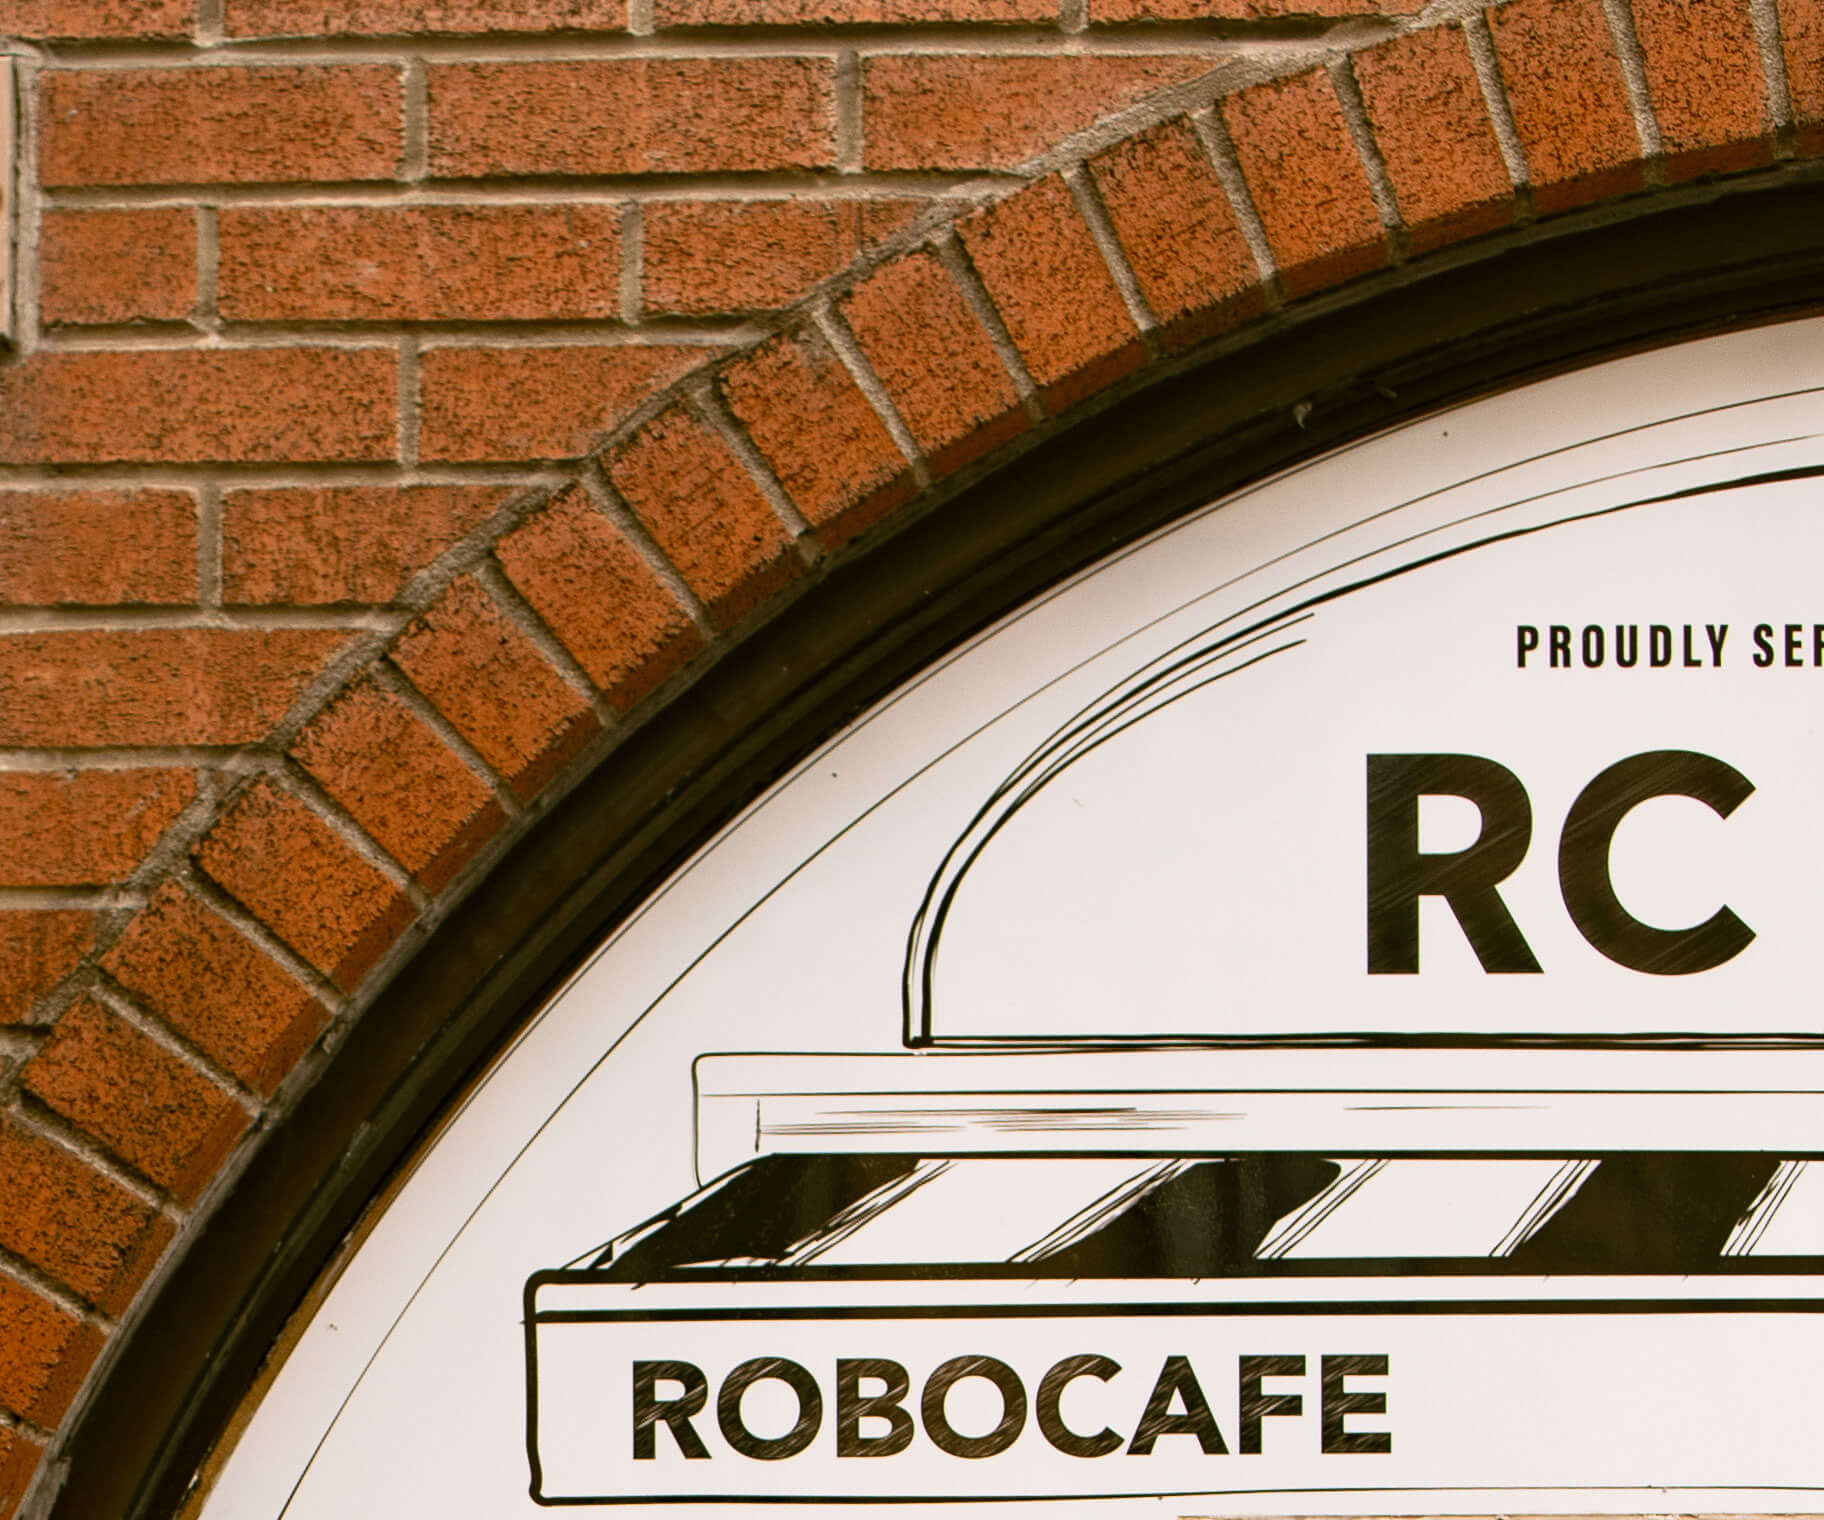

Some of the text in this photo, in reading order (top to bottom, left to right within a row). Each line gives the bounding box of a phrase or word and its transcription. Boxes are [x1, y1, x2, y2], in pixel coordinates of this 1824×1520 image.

[1517, 624, 1729, 669] PROUDLY
[1366, 749, 1757, 976] RC
[632, 1353, 1392, 1462] ROBOCAFE
